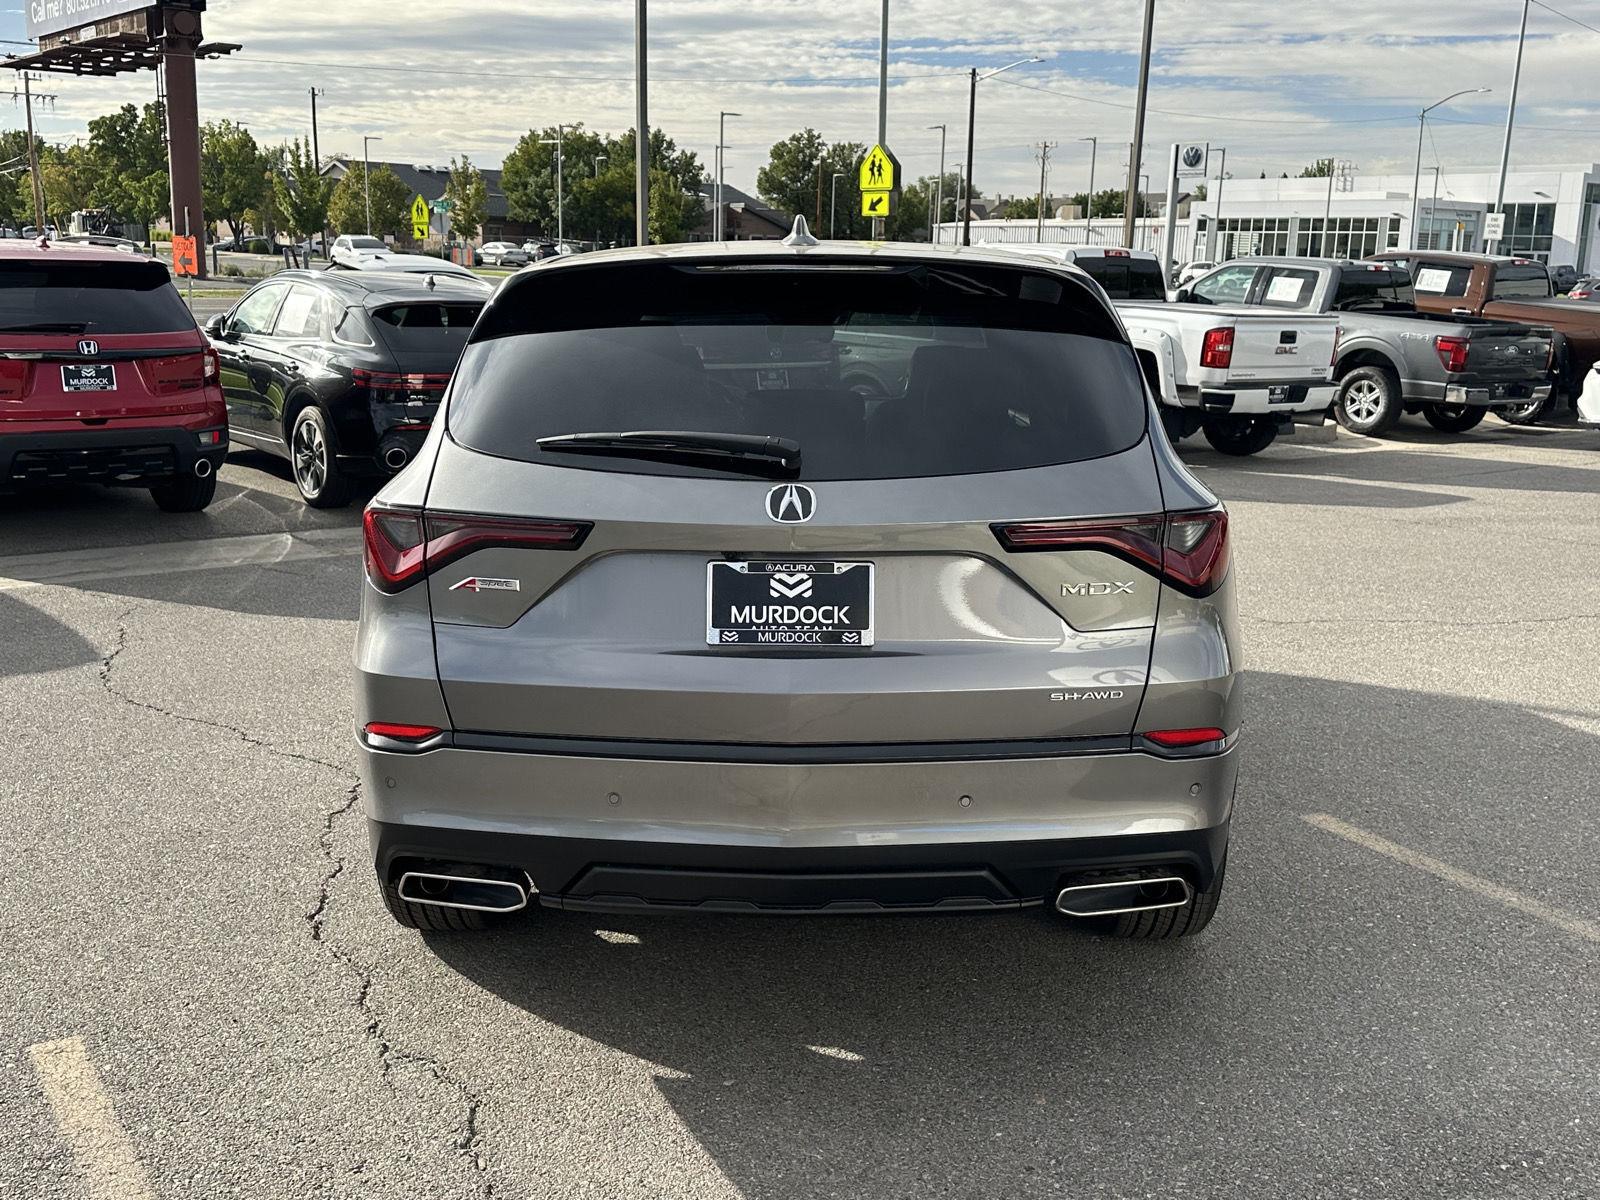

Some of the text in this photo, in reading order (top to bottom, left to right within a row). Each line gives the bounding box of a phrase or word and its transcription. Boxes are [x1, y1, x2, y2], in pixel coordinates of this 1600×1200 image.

[31, 0, 46, 24] Call
[1275, 346, 1298, 355] GMC
[70, 377, 109, 386] MURDOCK
[774, 563, 816, 572] ACURA
[1060, 580, 1135, 597] MDX
[730, 605, 850, 624] MURDOCK
[757, 632, 822, 642] MURDOCK
[1050, 690, 1124, 701] SH-AWD
